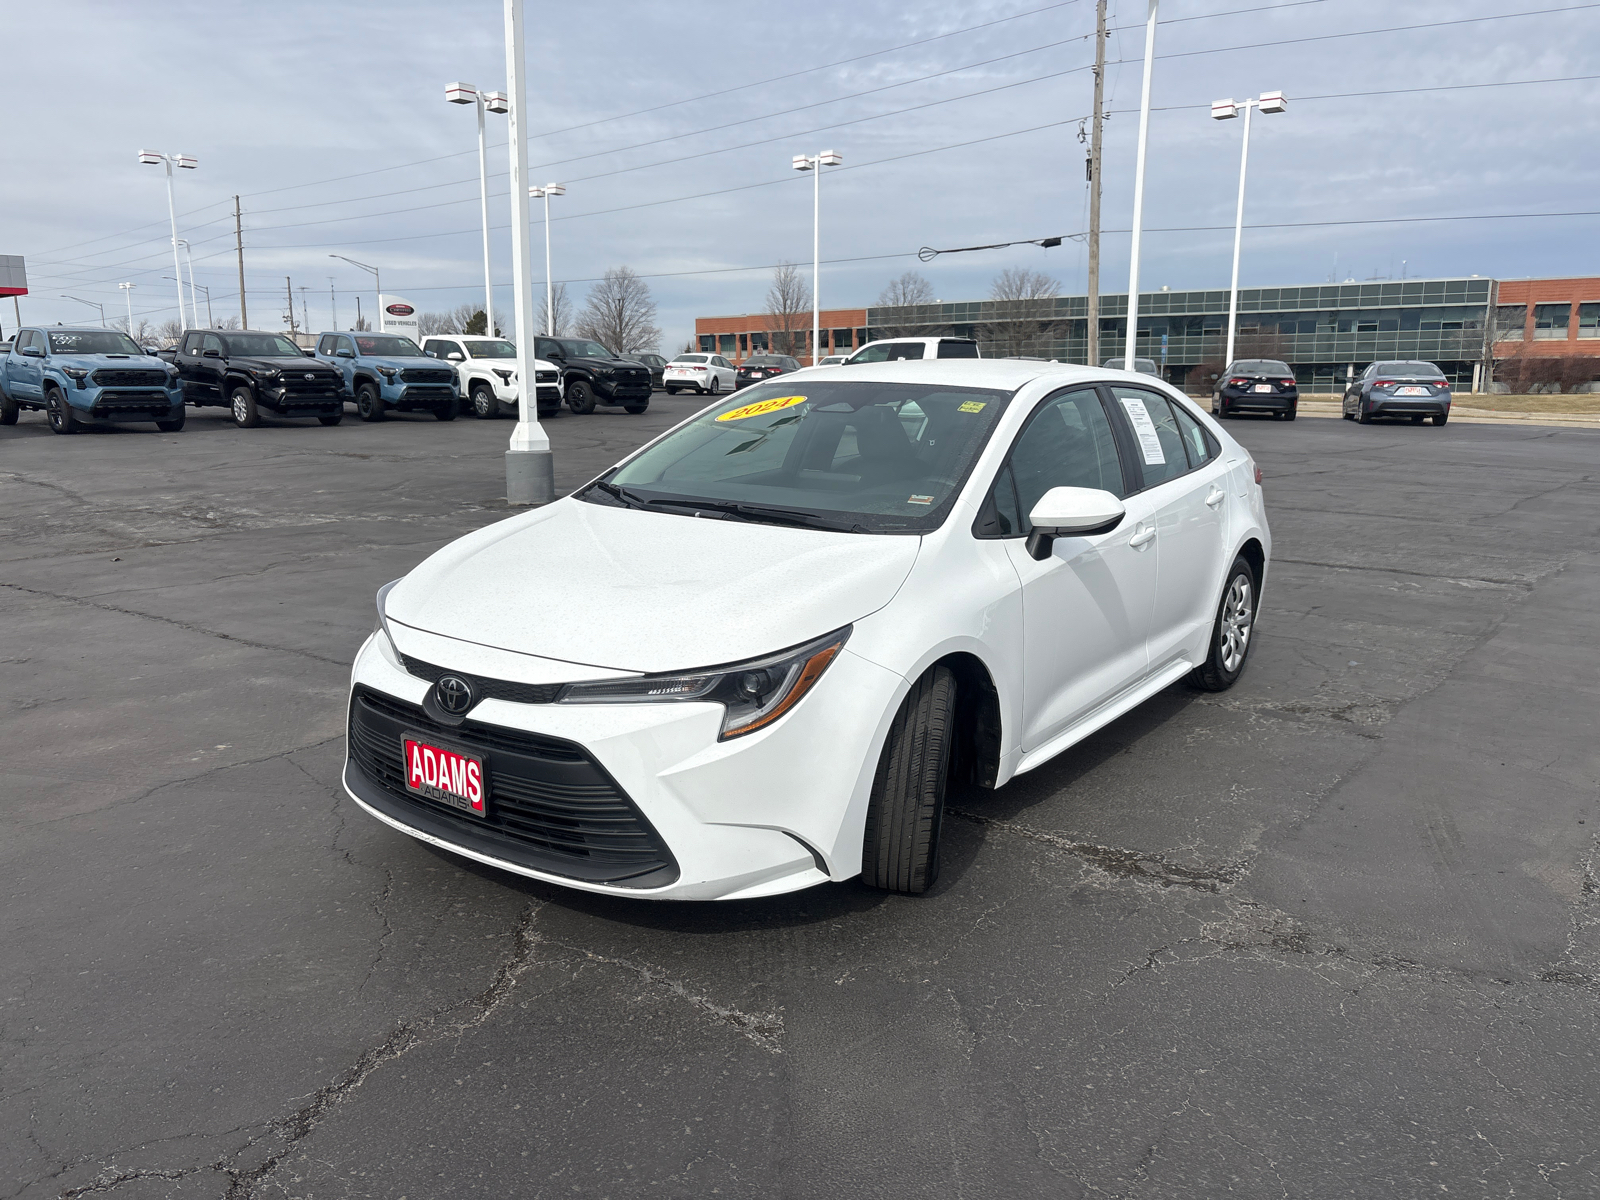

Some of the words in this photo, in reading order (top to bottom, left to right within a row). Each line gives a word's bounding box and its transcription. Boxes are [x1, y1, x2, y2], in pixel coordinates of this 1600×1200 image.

[729, 397, 794, 419] 2024
[412, 745, 482, 803] ADAMS
[423, 785, 468, 809] ADAMS
